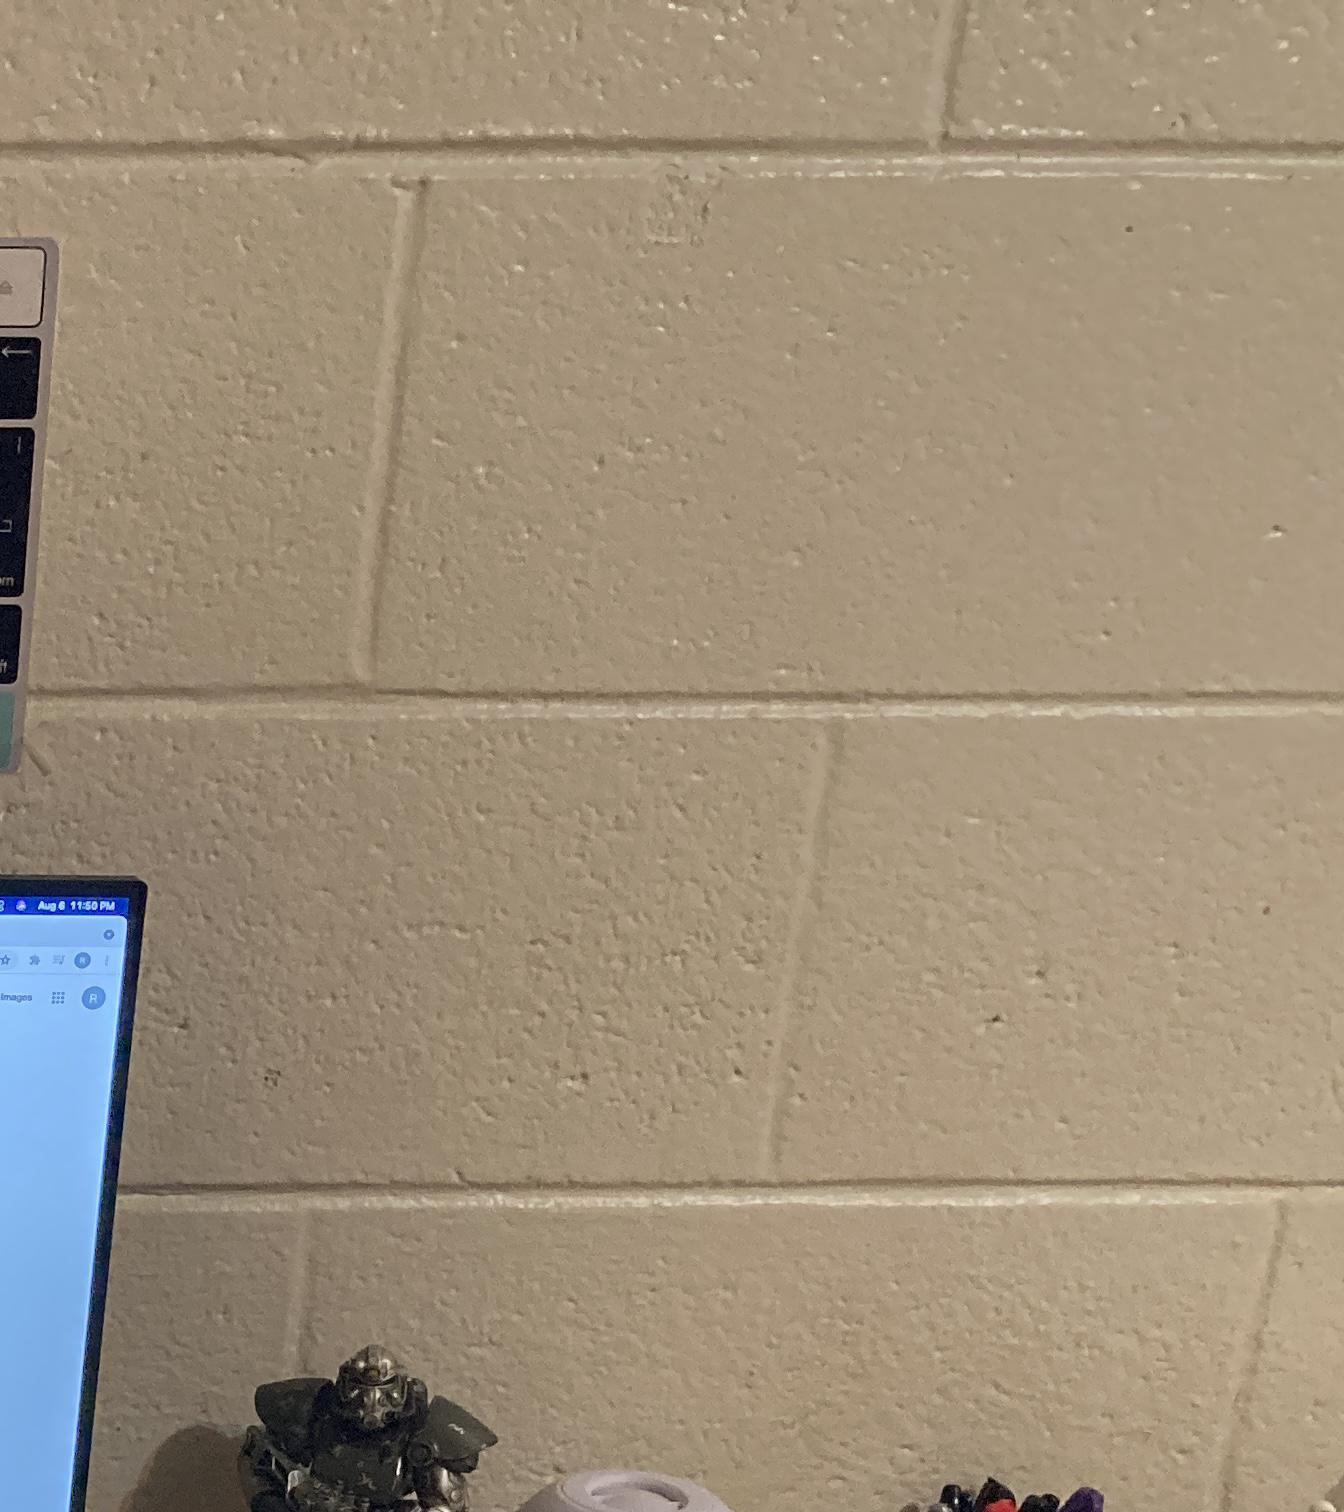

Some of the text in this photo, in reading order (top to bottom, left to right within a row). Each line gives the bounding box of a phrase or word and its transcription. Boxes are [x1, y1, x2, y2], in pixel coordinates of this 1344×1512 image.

[38, 900, 57, 913] Aug
[70, 901, 99, 911] 11:50
[100, 901, 115, 911] PM
[0, 993, 32, 1004] Images
